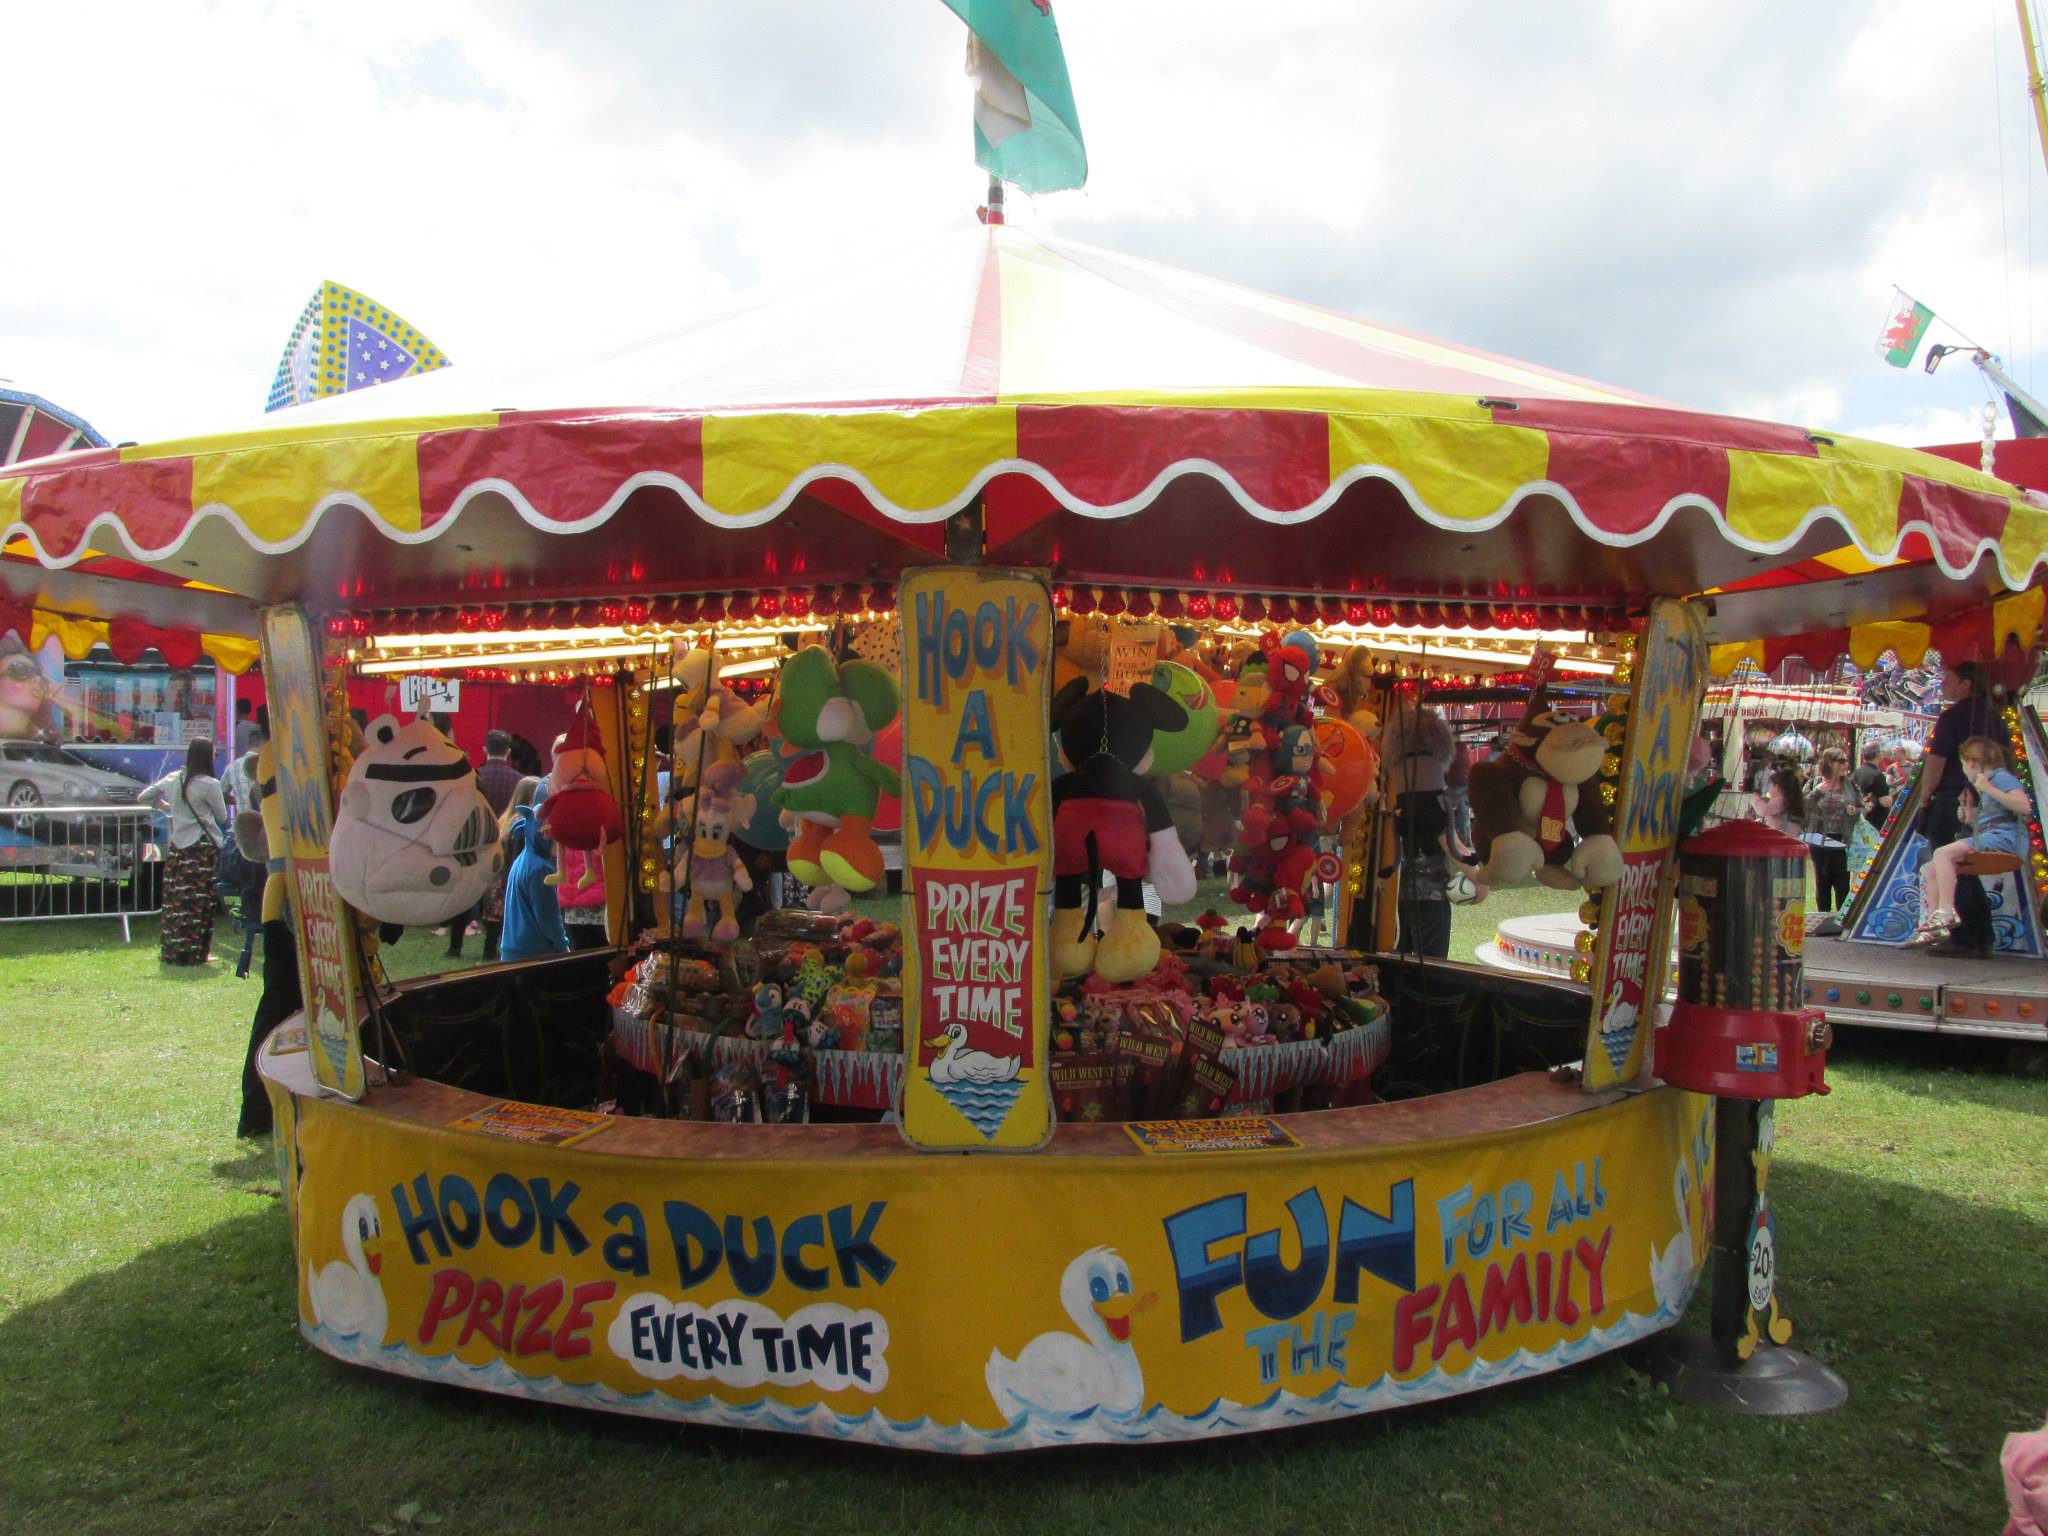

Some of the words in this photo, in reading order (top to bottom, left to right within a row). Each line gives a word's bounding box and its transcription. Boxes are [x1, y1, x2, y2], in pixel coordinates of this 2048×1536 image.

[916, 590, 1040, 708] HOOK
[1117, 647, 1149, 657] WIN
[291, 710, 309, 769] A
[952, 689, 997, 764] A
[1649, 703, 1670, 772] A
[908, 755, 1040, 855] DUCK
[925, 878, 1025, 937] PRIZE
[1617, 860, 1662, 911] PRIZE
[1616, 910, 1654, 951] EVERY
[311, 956, 345, 1006] TIME
[931, 937, 1030, 984] EVERY
[1612, 952, 1647, 989] TIME
[932, 984, 1023, 1040] TIME
[1188, 1021, 1206, 1039] WILD
[1206, 1029, 1224, 1047] WEST
[1052, 1067, 1077, 1082] WILD
[1079, 1066, 1105, 1080] WEST
[1119, 1037, 1141, 1053] WILD
[1144, 1043, 1169, 1059] WEST
[1195, 1059, 1213, 1077] WILD
[1213, 1068, 1234, 1088] WEST
[391, 1171, 592, 1265] HOOK
[602, 1201, 651, 1277] a
[662, 1201, 898, 1297] DUCK
[1437, 1181, 1533, 1271] FOR
[1545, 1157, 1606, 1236] ALL
[1162, 1177, 1417, 1343] FUN
[417, 1268, 616, 1360] PRIZE
[1245, 1309, 1357, 1385] THE
[1392, 1226, 1613, 1374] FAMILY
[629, 1303, 750, 1371] EVERY
